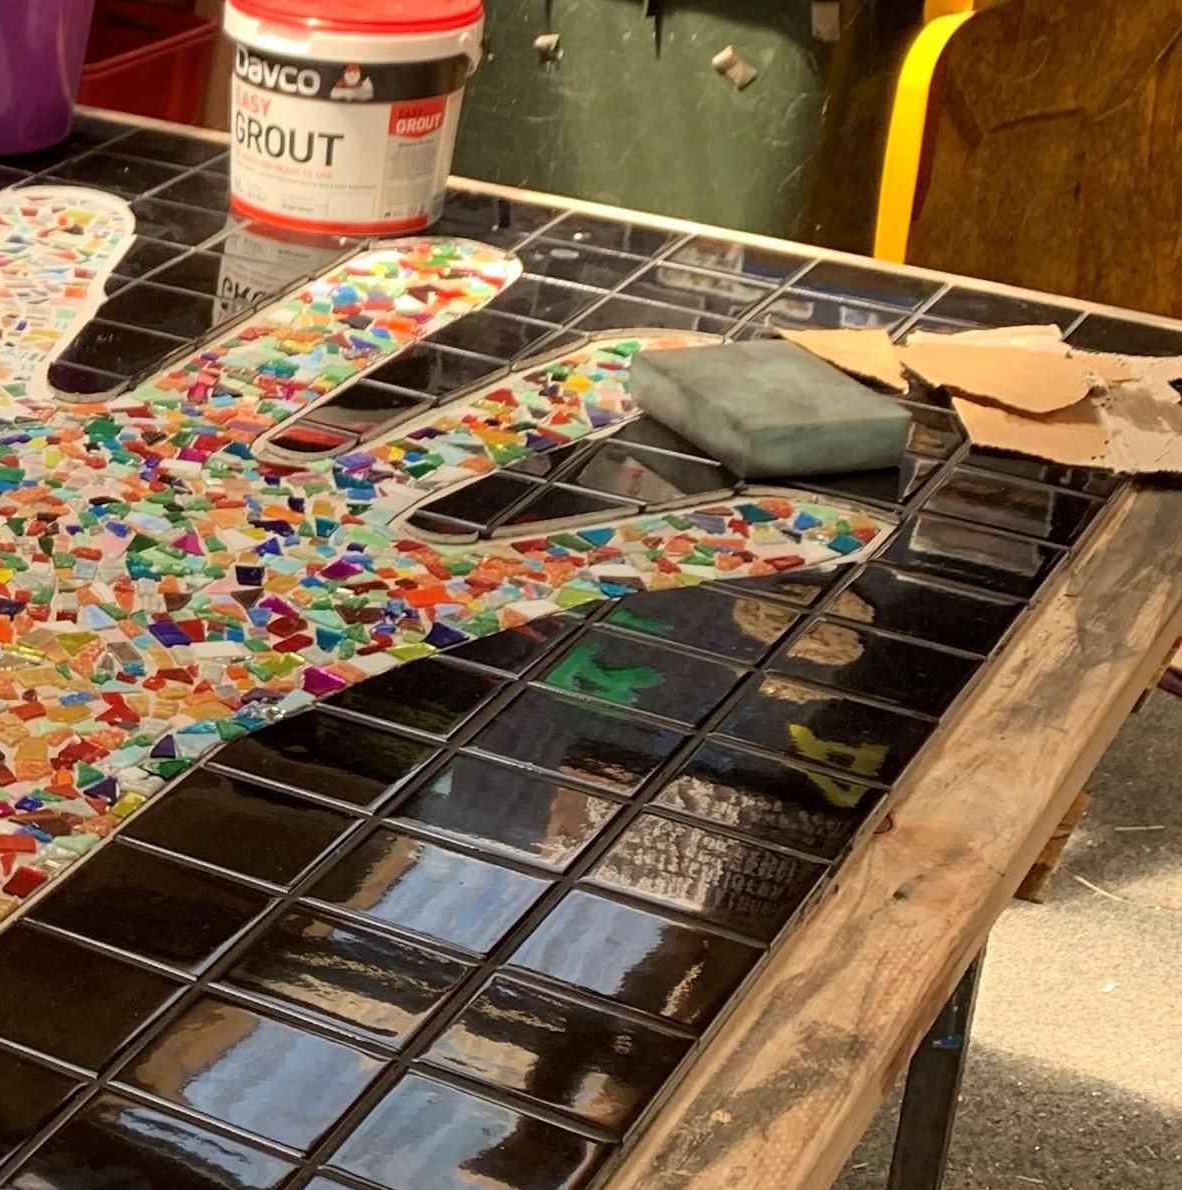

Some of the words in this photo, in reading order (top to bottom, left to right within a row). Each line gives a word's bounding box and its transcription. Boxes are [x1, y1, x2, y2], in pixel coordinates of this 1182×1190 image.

[235, 43, 321, 97] Davco
[235, 83, 271, 116] EASY
[235, 110, 345, 167] GROUT
[396, 112, 443, 134] GROUT
